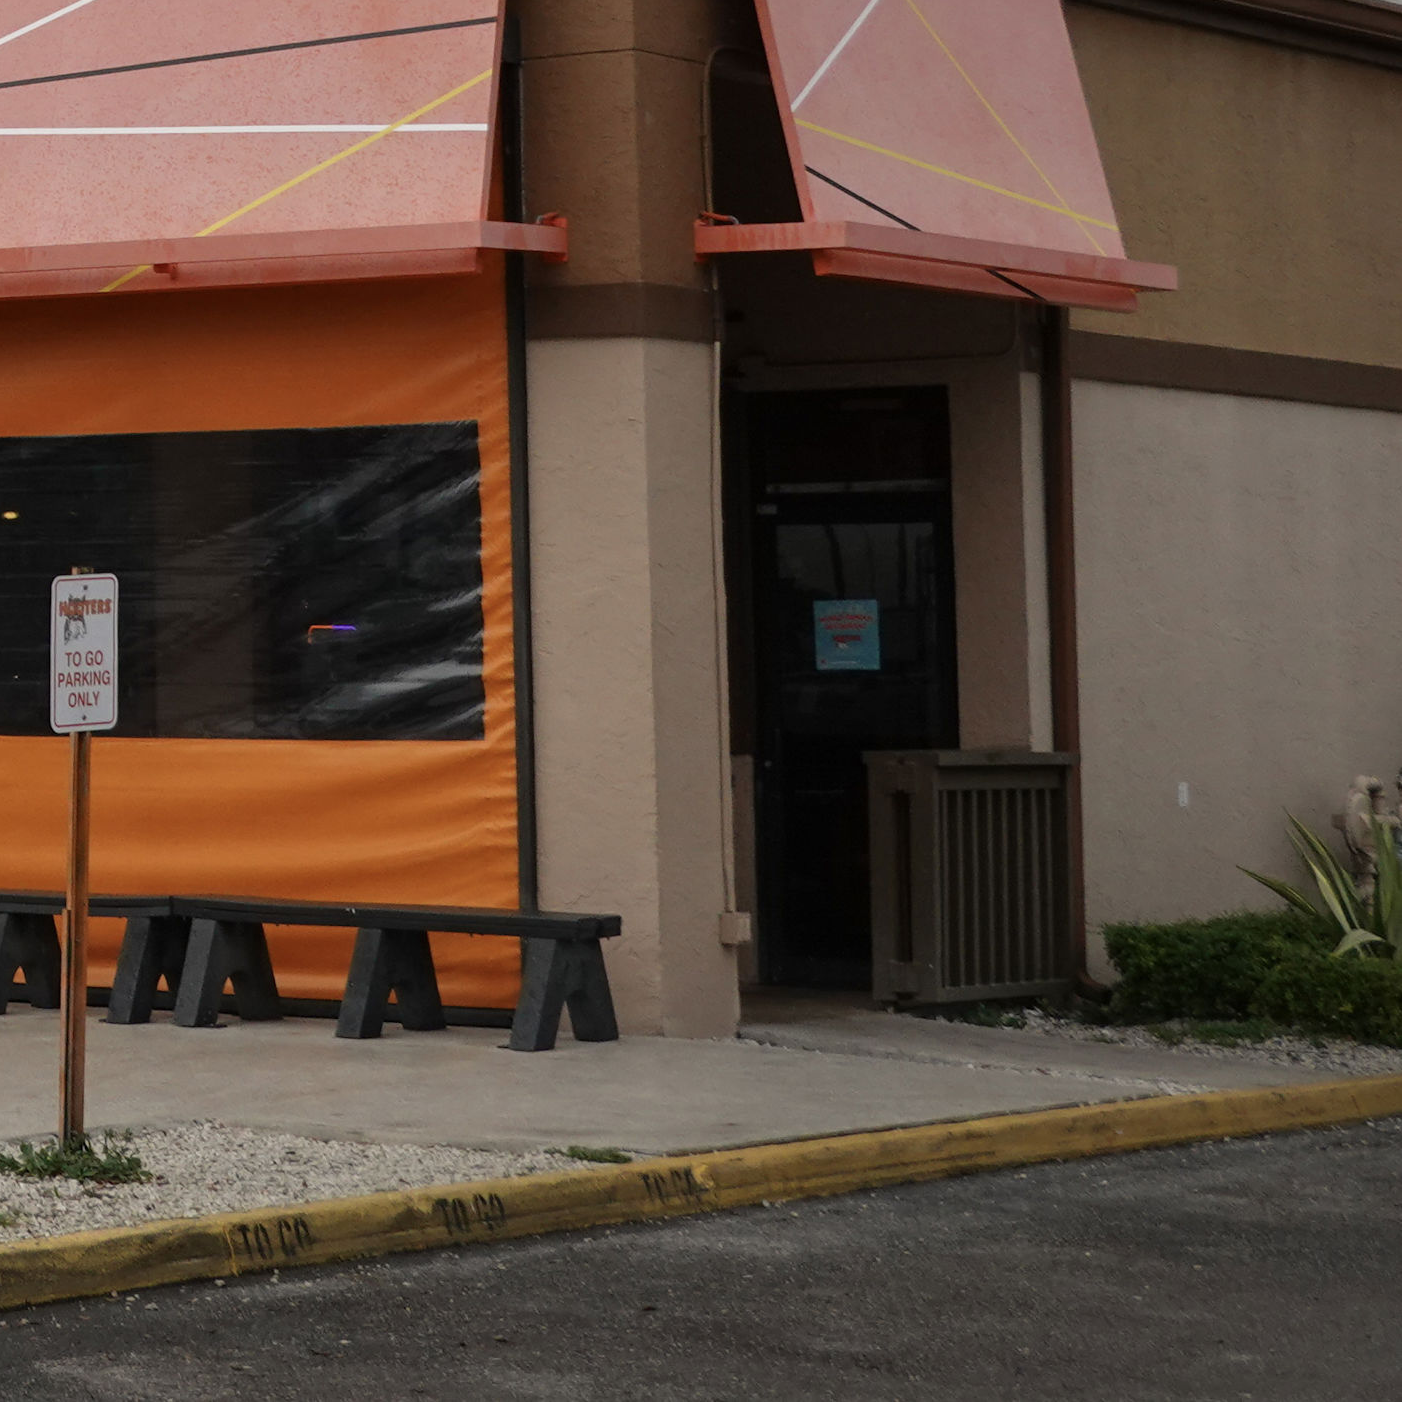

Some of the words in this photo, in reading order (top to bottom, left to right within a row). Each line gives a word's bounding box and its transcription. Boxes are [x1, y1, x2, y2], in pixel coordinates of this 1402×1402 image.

[59, 599, 112, 616] HOOTERS
[65, 651, 82, 667] TO
[85, 650, 104, 666] GO
[58, 670, 111, 688] PARKING
[68, 691, 100, 708] ONLY
[232, 1221, 274, 1260] TO
[277, 1214, 314, 1257] GO
